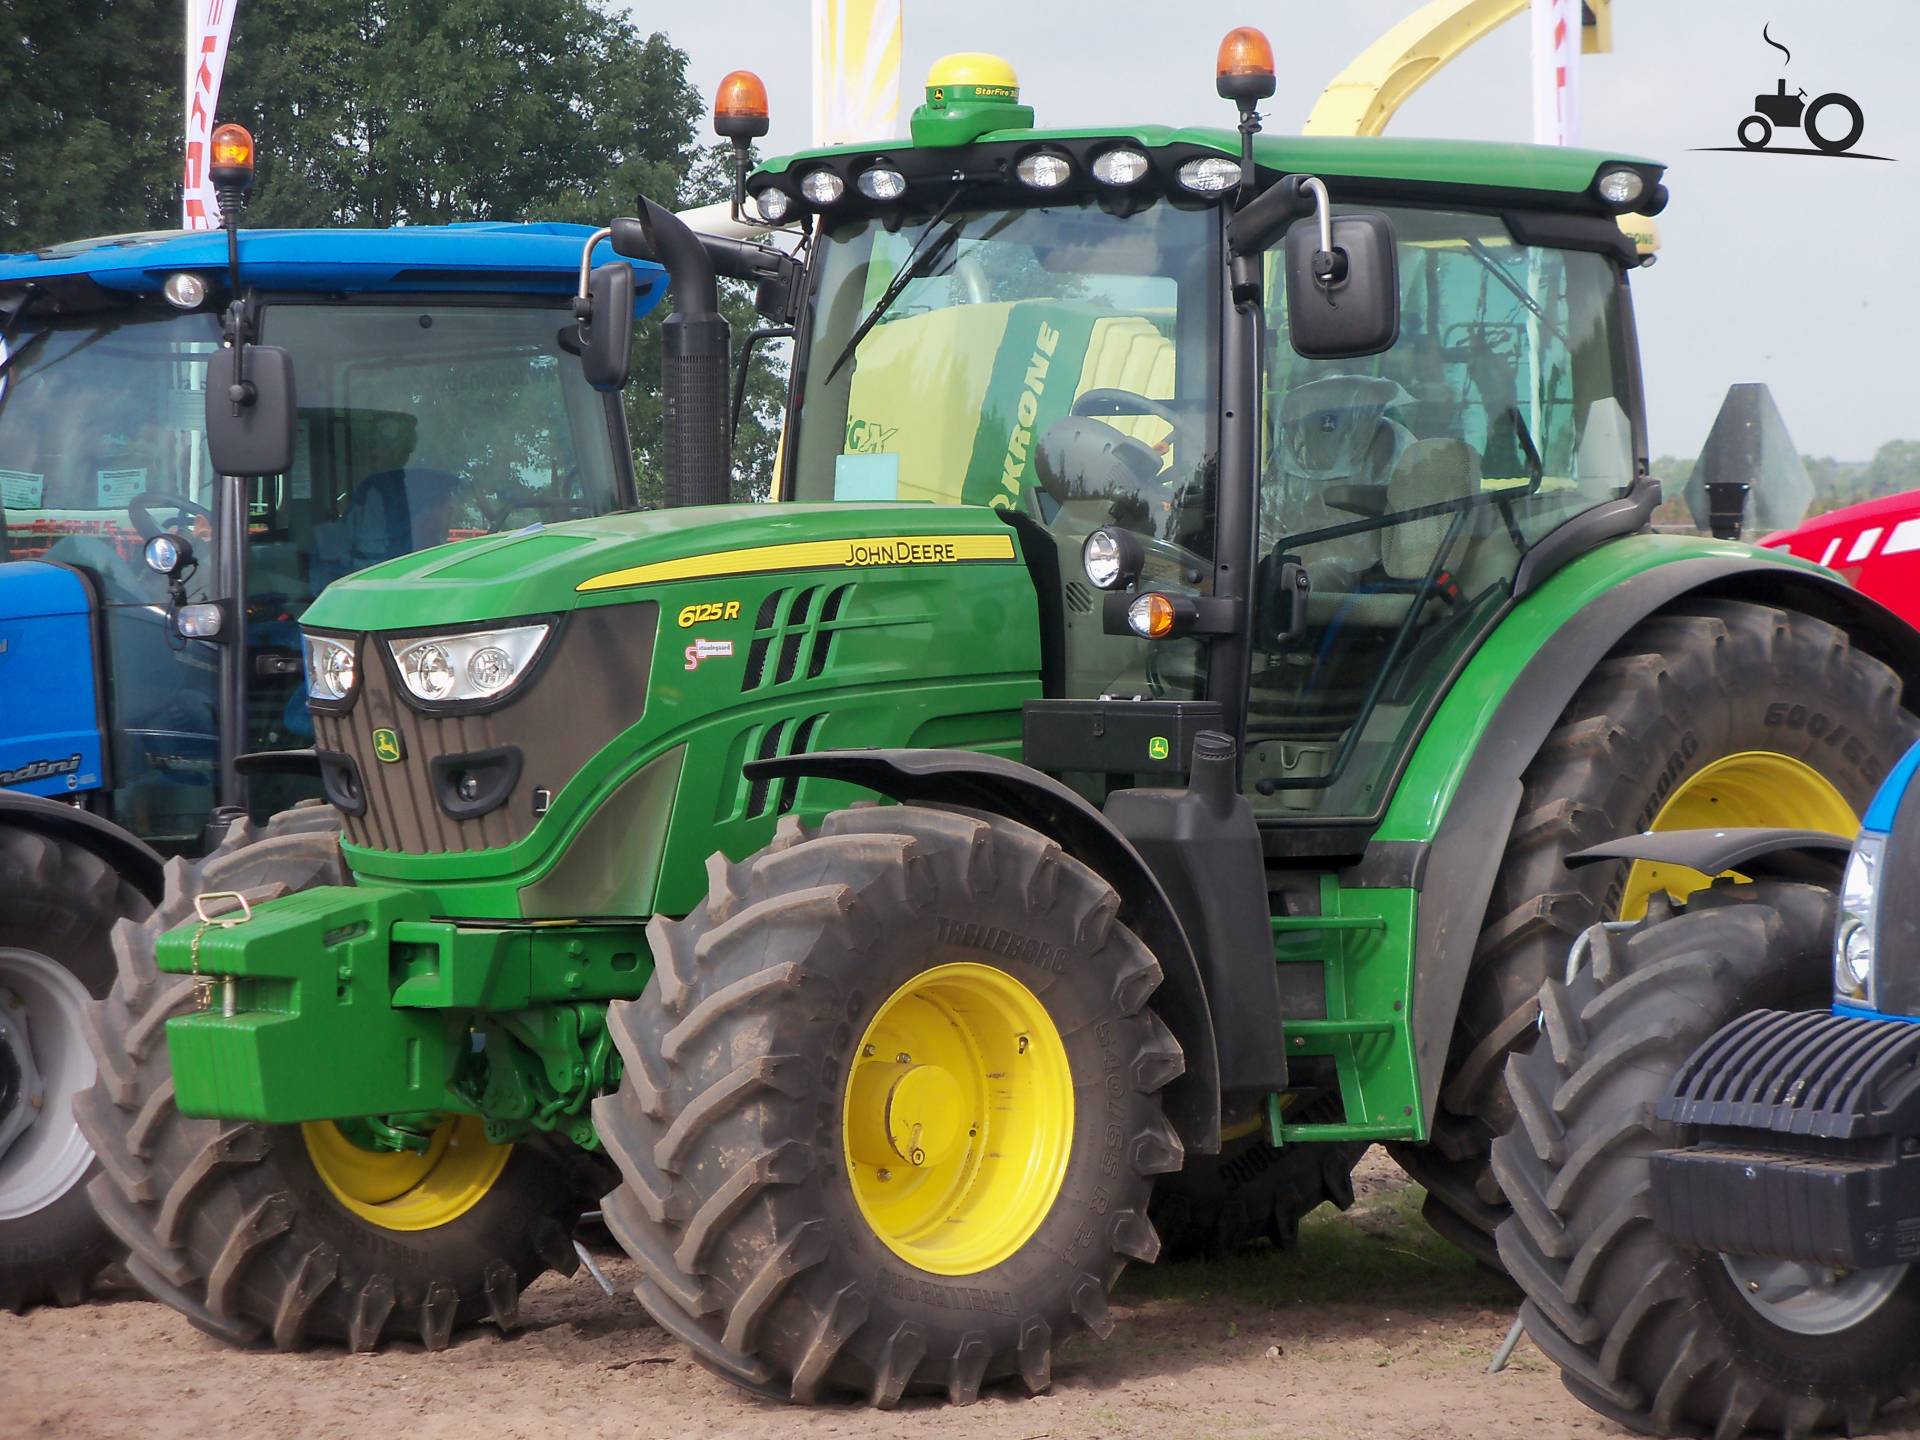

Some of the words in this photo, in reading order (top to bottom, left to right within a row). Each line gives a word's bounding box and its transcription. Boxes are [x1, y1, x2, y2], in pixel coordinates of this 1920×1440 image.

[1001, 320, 1060, 496] KRONE
[845, 543, 894, 564] JOHN
[896, 541, 956, 561] DEERE
[0, 753, 81, 784] ndini
[936, 915, 1072, 976] TRELLEBORG
[1095, 1019, 1126, 1179] 540/65
